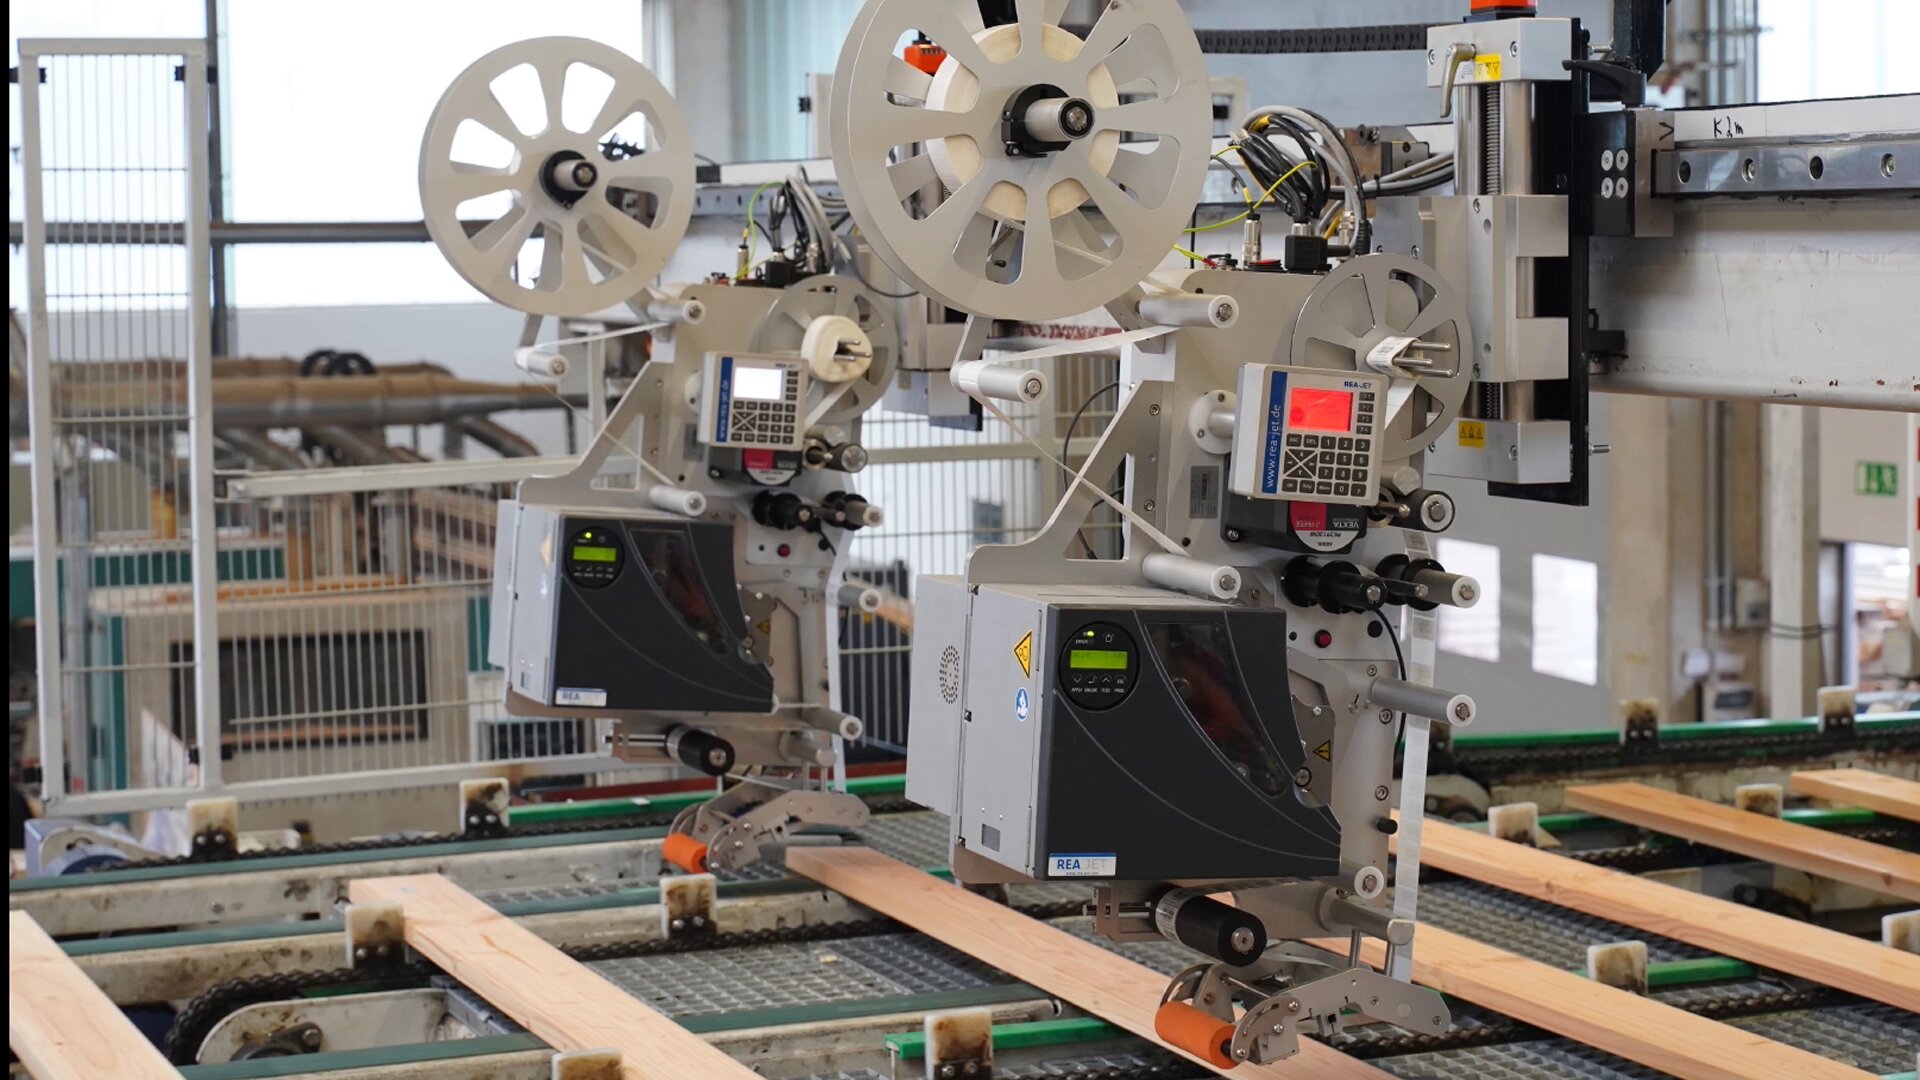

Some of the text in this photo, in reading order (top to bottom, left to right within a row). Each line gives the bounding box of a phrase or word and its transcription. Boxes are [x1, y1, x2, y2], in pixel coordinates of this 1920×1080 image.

[1266, 403, 1281, 488] www.rea-jet.de
[1332, 521, 1360, 529] VEXTA
[562, 692, 580, 700] REA
[1057, 859, 1107, 870] REA JET
